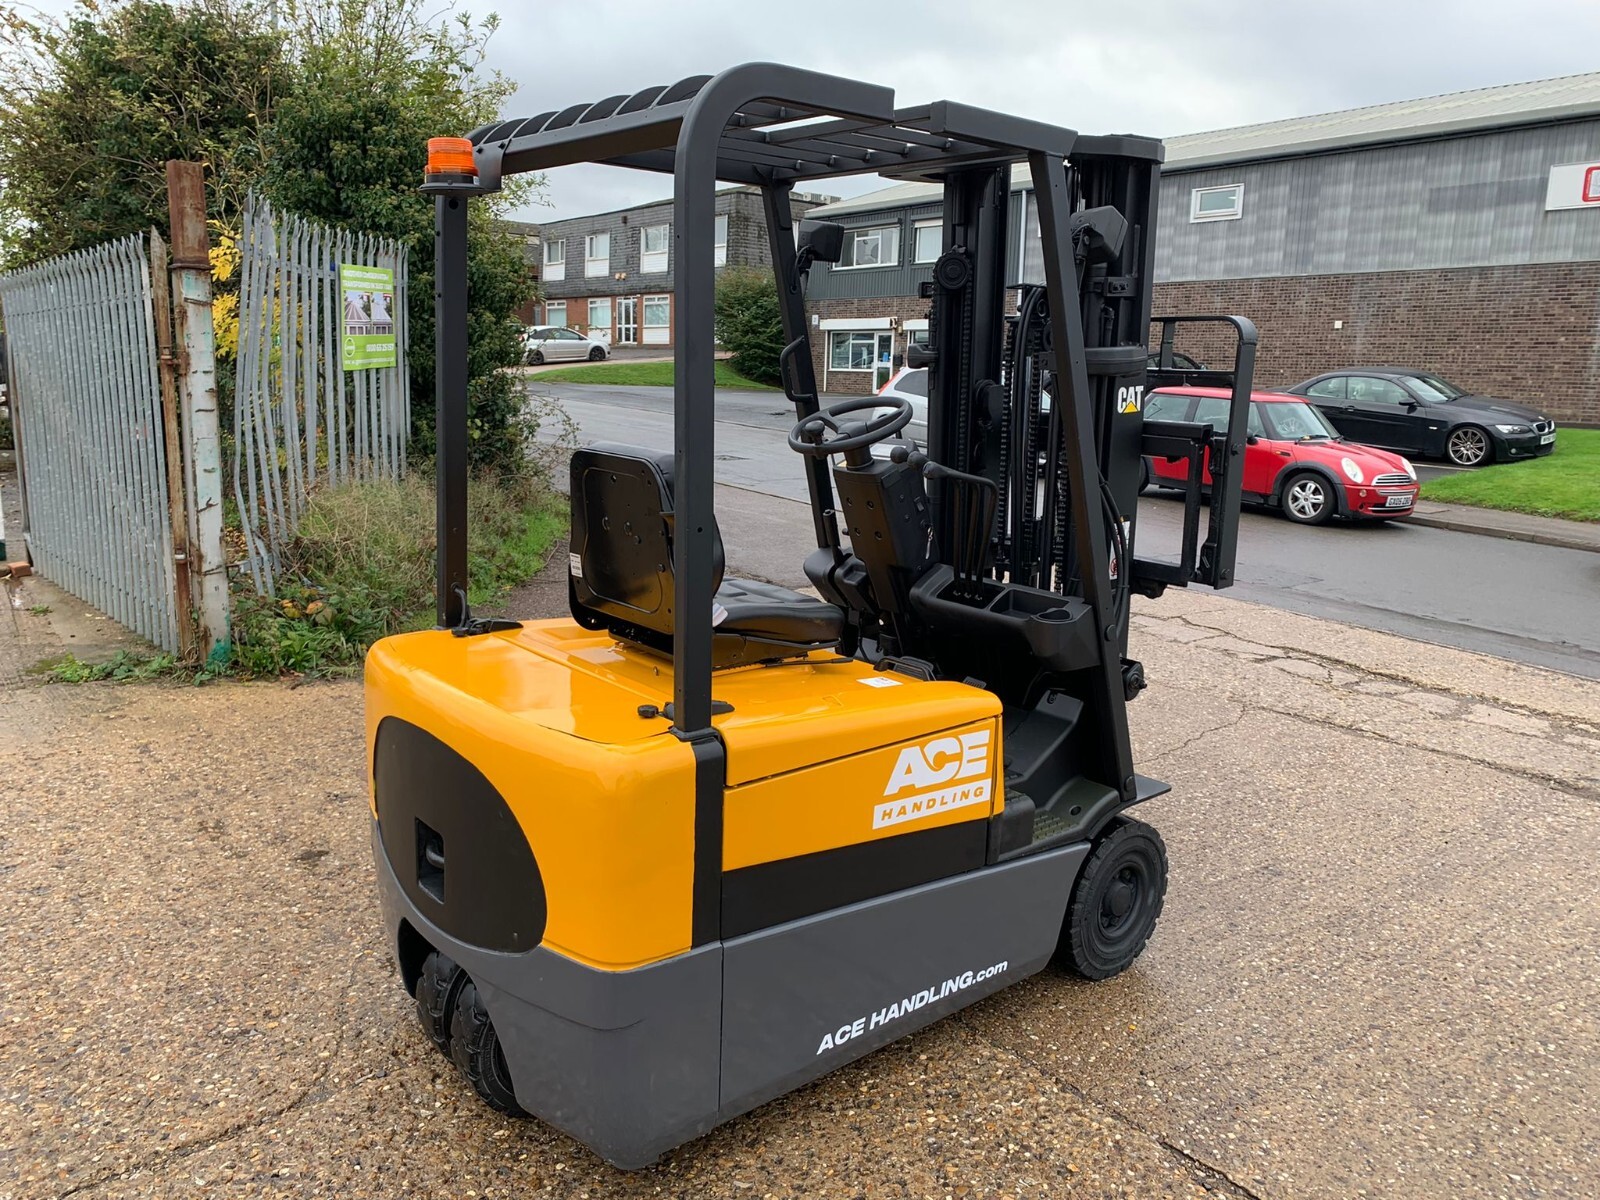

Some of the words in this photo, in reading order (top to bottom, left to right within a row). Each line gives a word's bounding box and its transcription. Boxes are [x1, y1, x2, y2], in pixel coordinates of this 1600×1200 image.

[1117, 385, 1144, 413] CAT
[883, 729, 990, 796] ACE
[881, 786, 984, 821] HANDLING
[816, 1017, 867, 1055] ACE
[869, 960, 1008, 1030] HANDLING.com
